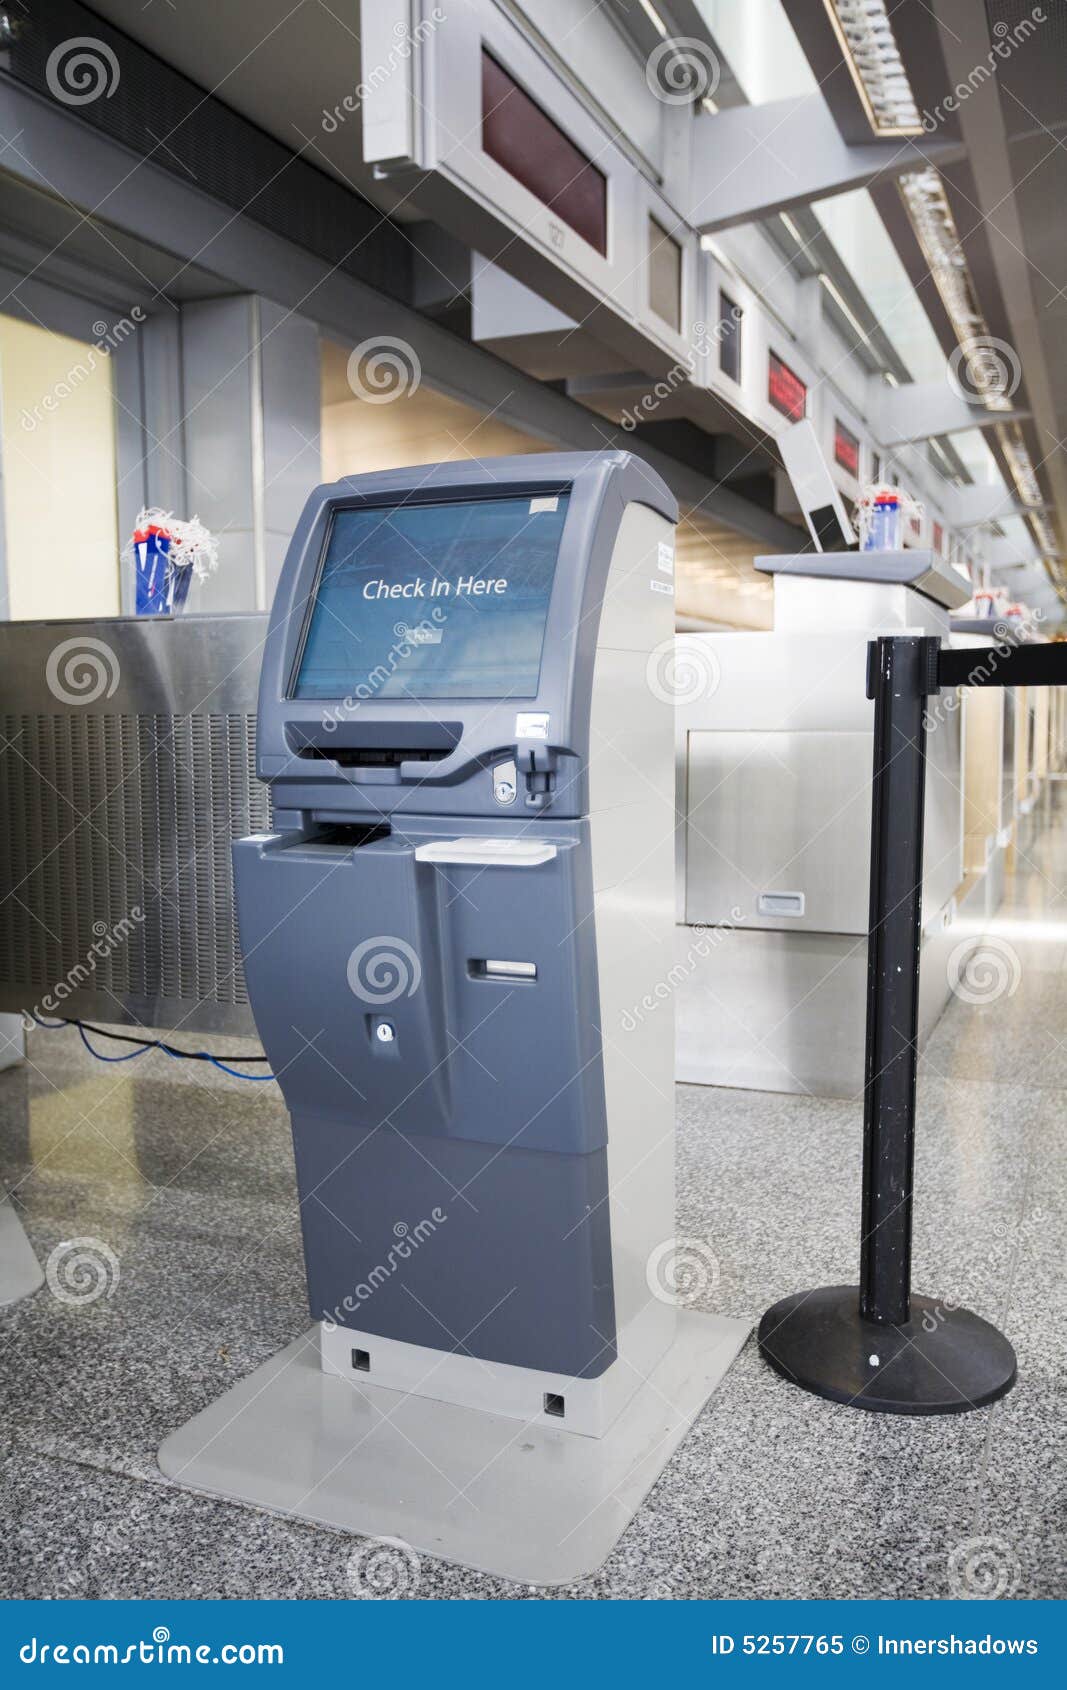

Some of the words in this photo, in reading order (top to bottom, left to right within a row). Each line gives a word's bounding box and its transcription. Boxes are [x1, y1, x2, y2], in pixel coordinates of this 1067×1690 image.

[362, 578, 425, 600] Check
[431, 576, 450, 596] In
[456, 576, 508, 595] Here
